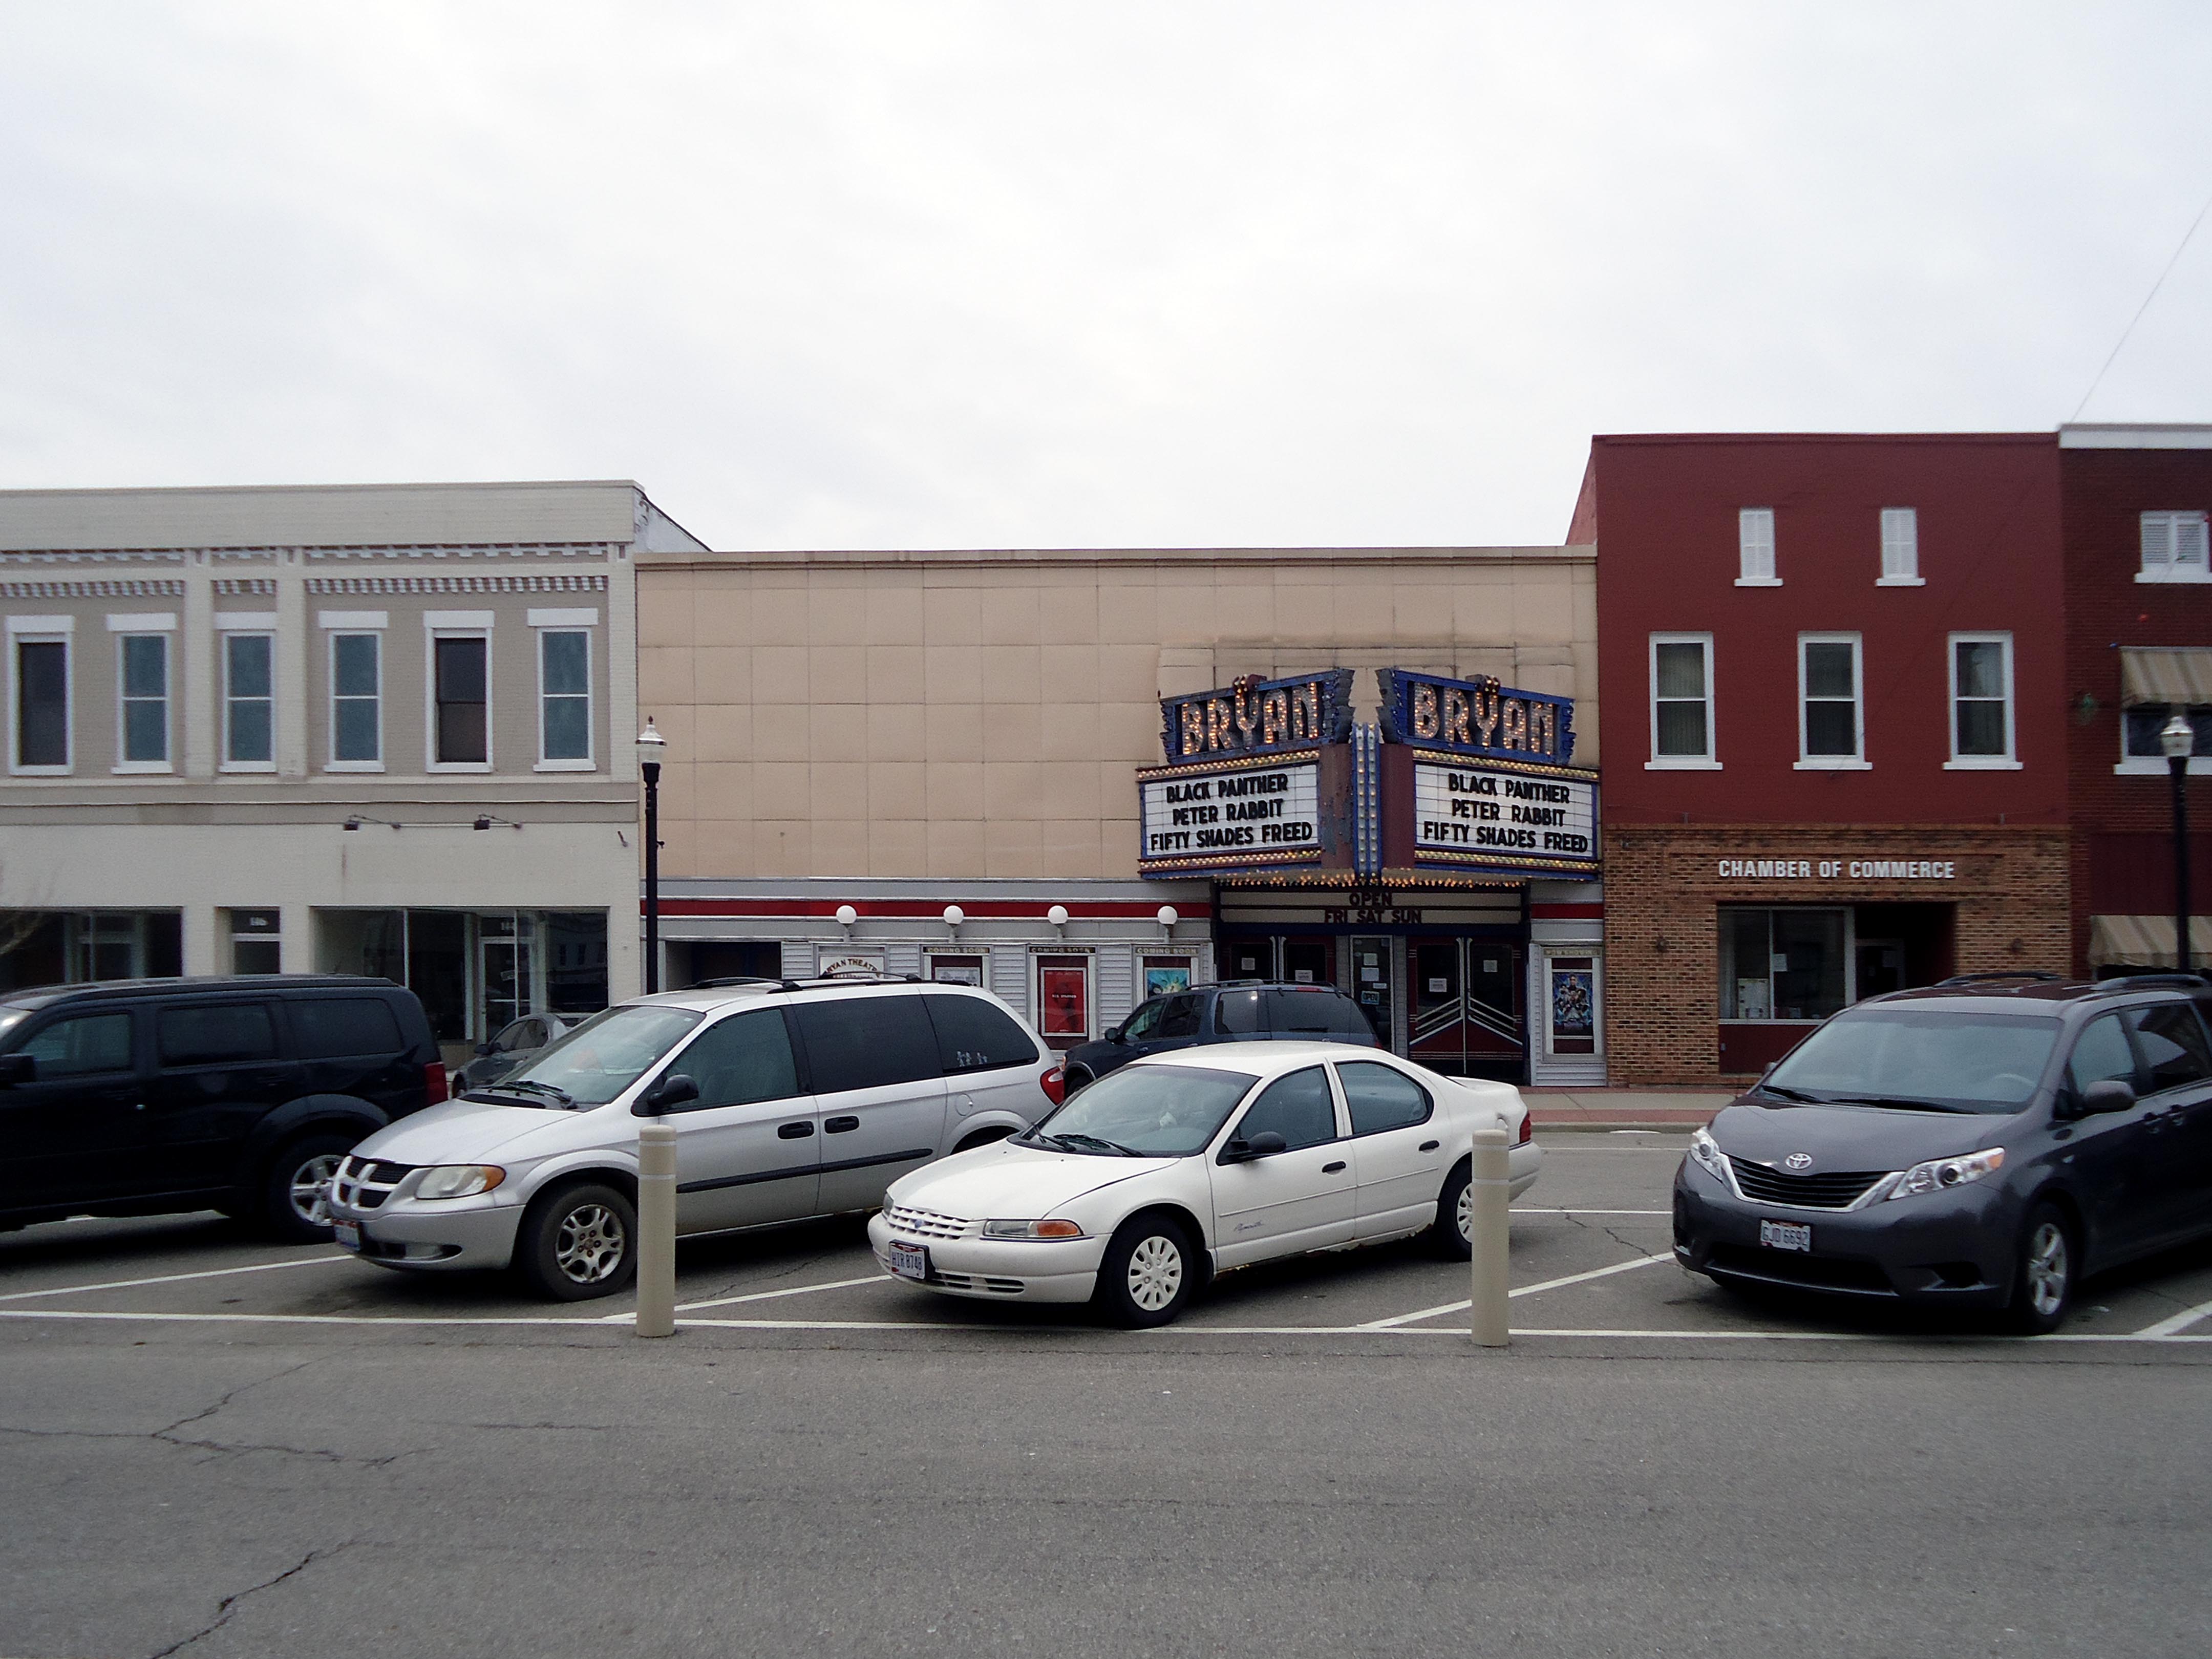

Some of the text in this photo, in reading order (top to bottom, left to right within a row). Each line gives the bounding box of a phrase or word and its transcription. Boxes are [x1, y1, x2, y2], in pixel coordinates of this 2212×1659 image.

[1181, 675, 1317, 755] BRYAN
[1414, 675, 1554, 755] BRYAN
[1166, 774, 1288, 803] BLACK PANTHER
[1449, 773, 1570, 803] BLACK PANTHER
[1173, 798, 1284, 826] PETER RABBIT
[1452, 798, 1566, 827] PETER RABBIT
[1151, 822, 1312, 851] FIFTY SHADES FREED
[1423, 821, 1588, 853] FIFTY SHADES FREED
[1718, 860, 1955, 879] CHAMBER OF COMMERCE
[1349, 892, 1392, 907] OPEN
[1325, 908, 1421, 924] FRI SAT SUN
[824, 959, 846, 973] RYAN
